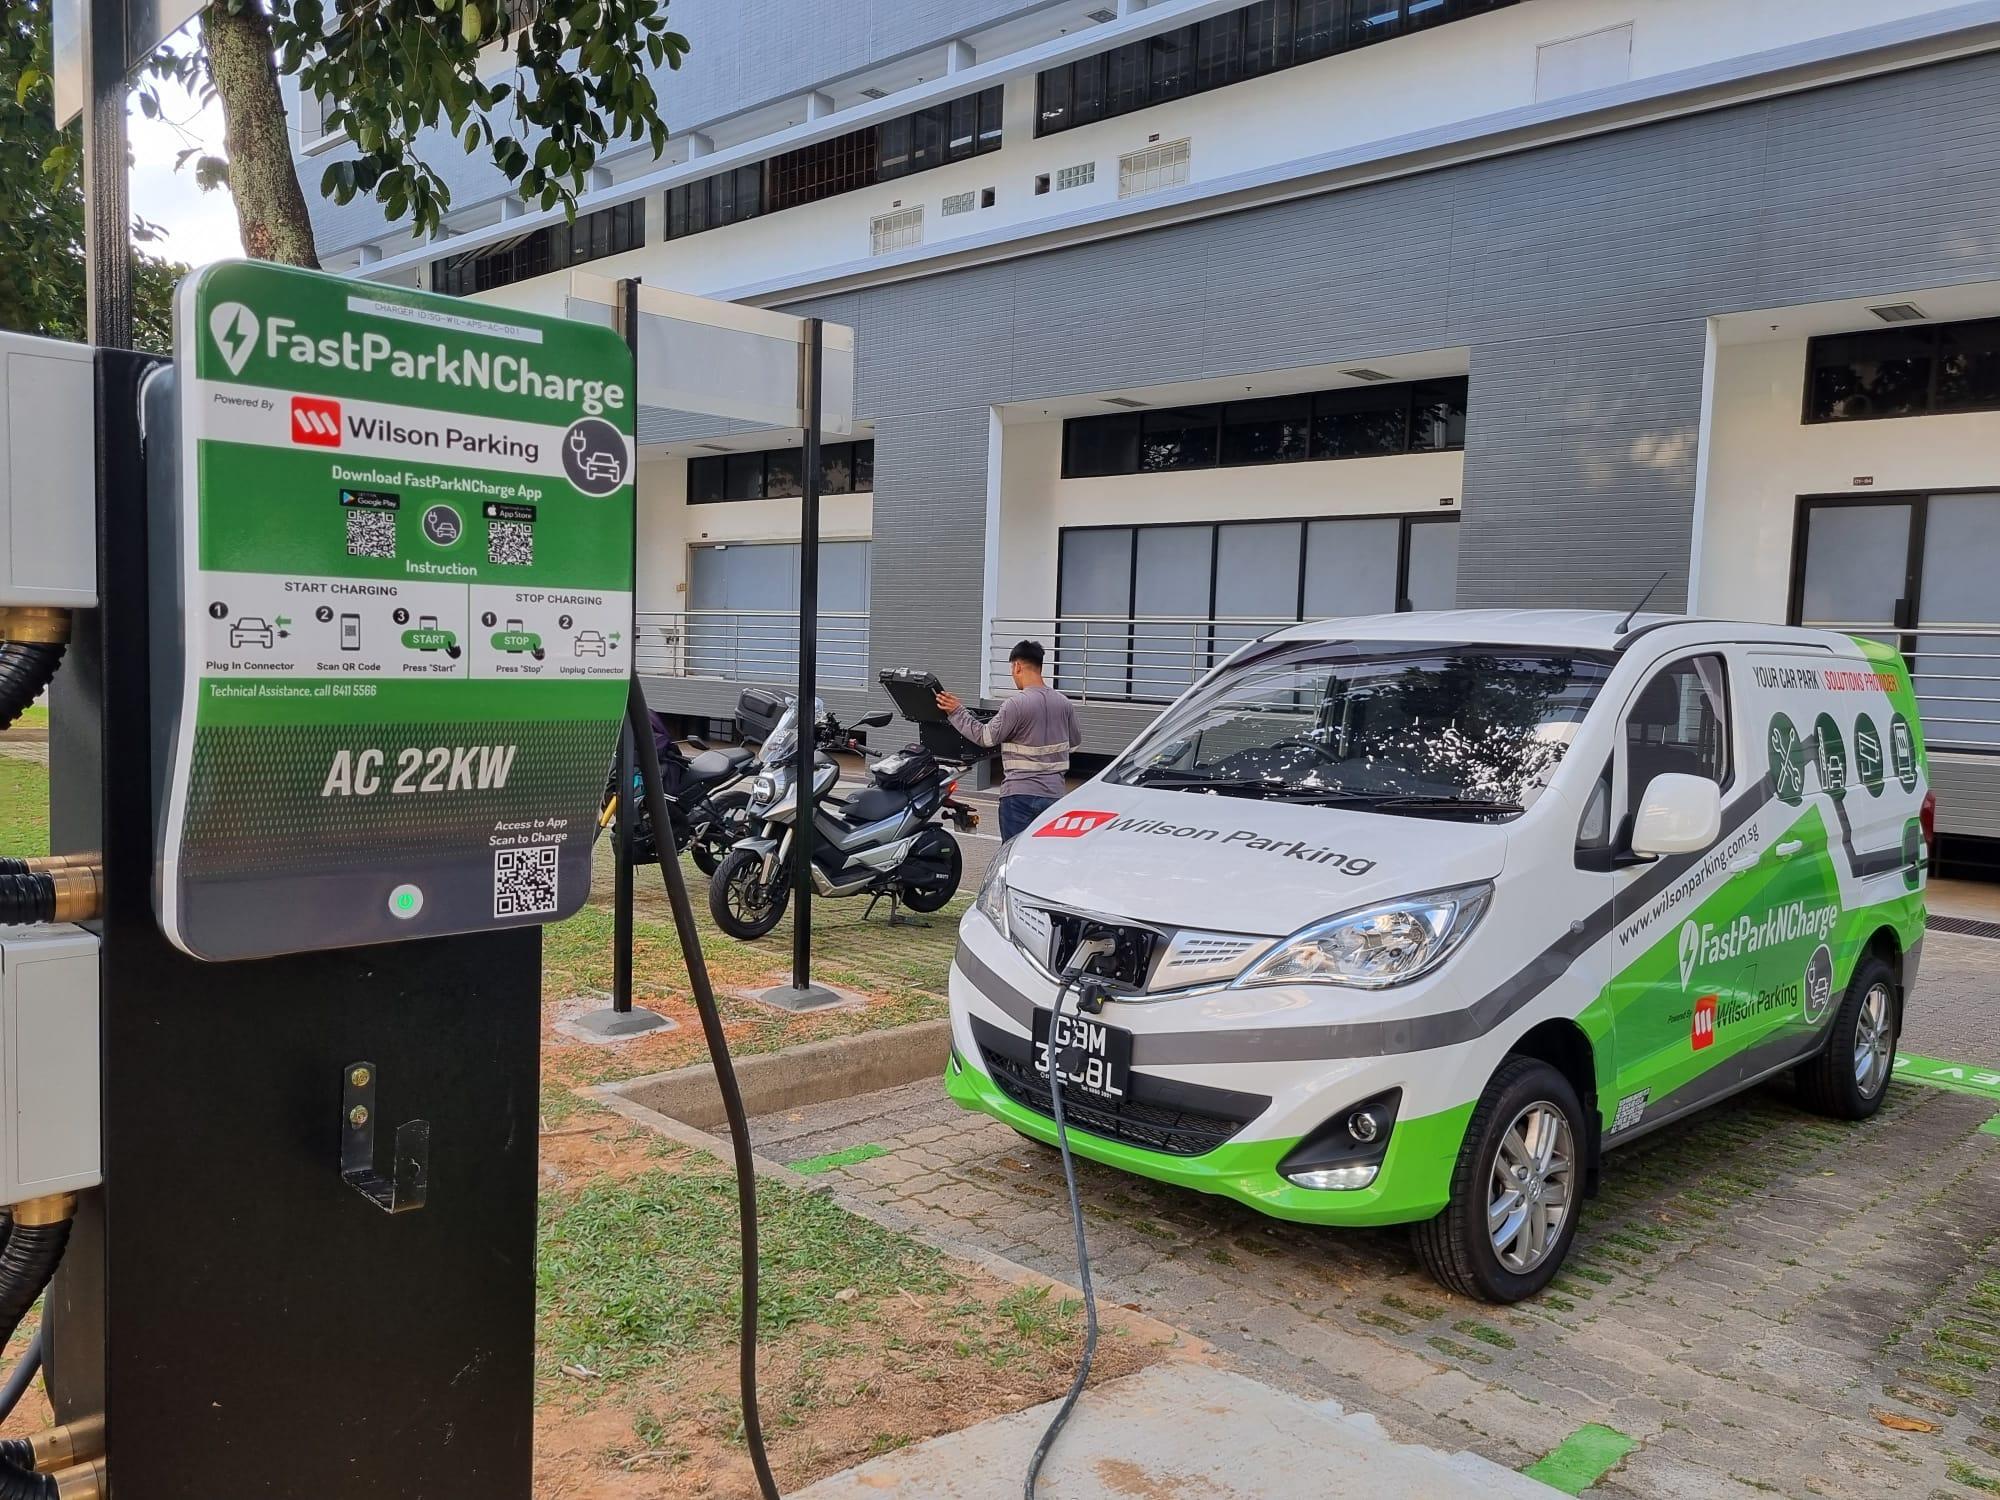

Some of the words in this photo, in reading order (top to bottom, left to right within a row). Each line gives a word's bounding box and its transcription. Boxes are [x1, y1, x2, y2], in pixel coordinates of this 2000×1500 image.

[375, 303, 414, 317] CHARGER
[266, 317, 625, 415] FastParkNCharge
[213, 393, 258, 409] Powered
[260, 398, 275, 411] By
[347, 415, 439, 448] Wilson
[446, 429, 540, 463] Parking
[332, 465, 401, 485] Download
[405, 473, 515, 499] FastParkNCharge
[517, 484, 542, 501] App
[357, 497, 382, 507] Google
[382, 499, 397, 508] Play
[499, 509, 514, 518] App
[514, 511, 532, 519] Store
[406, 560, 478, 576] Instruction
[285, 582, 328, 593] START
[330, 584, 398, 597] CHARGING
[515, 593, 545, 603] STOP
[547, 595, 603, 606] CHARGING
[214, 605, 222, 617] 1
[320, 608, 329, 620] 2
[397, 611, 405, 622] 3
[412, 634, 445, 645] START
[503, 636, 530, 646] STOP
[206, 661, 229, 671] Plug
[232, 662, 241, 670] In
[244, 662, 295, 671] Connector
[316, 662, 340, 671] Scan
[342, 662, 355, 671] QR
[358, 662, 381, 671] Code
[403, 664, 427, 672] Press
[429, 663, 457, 673] "Start"
[496, 664, 519, 673] Press
[520, 664, 544, 675] "Stop"
[559, 666, 586, 675] Unplug
[587, 666, 624, 675] Connector
[1752, 666, 1779, 689] YOUR
[1778, 667, 1798, 689] CAR
[1797, 670, 1819, 690] PARK
[1824, 670, 1864, 692] SOLUTIONS
[1865, 672, 1899, 692] PROVIDER
[210, 684, 257, 697] Technical
[314, 685, 331, 697] call
[332, 685, 350, 697] 6411
[352, 685, 377, 697] 5566
[320, 748, 384, 797] AC
[392, 745, 516, 794] 22KW
[494, 820, 531, 831] Access
[533, 819, 544, 828] to
[546, 817, 568, 830] App
[489, 835, 515, 846] Scan
[517, 834, 529, 844] to
[531, 831, 568, 843] Charge
[1104, 817, 1220, 841] Wilson
[1220, 830, 1377, 876] Parking
[1618, 822, 1760, 947] www.wilsonparking.com.sg
[1700, 900, 1838, 965] FastParkNCharge
[1716, 993, 1756, 1028] Wilson
[1756, 983, 1798, 1014] Parking
[1055, 1015, 1106, 1057] GBM
[1034, 1041, 1123, 1096] 38L
